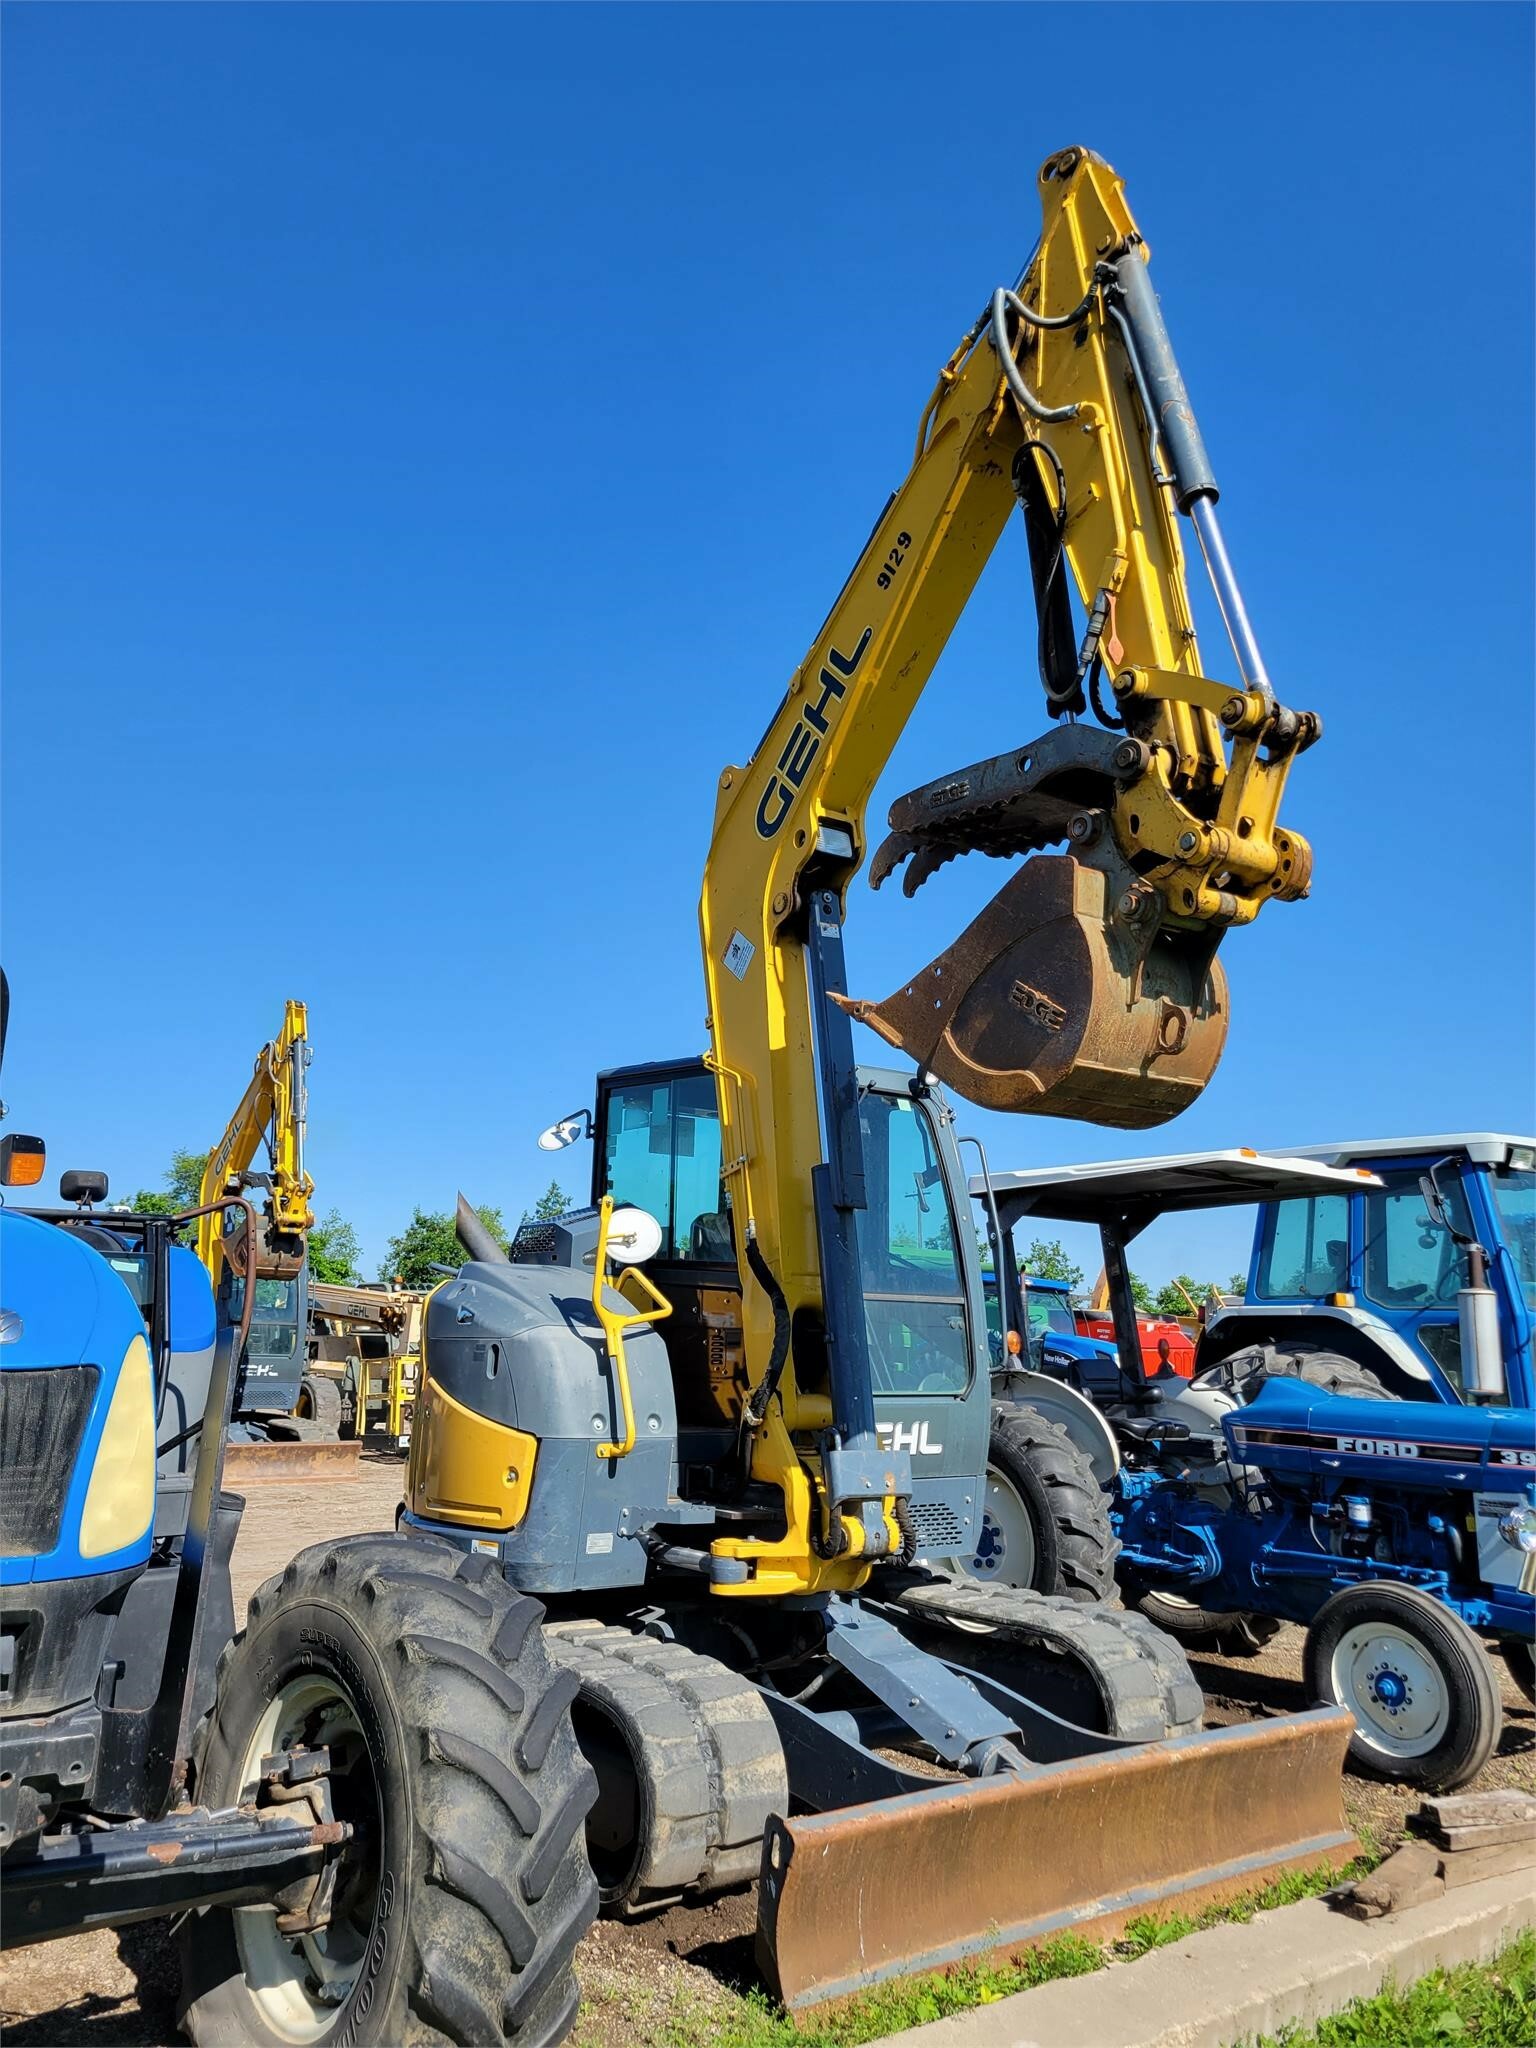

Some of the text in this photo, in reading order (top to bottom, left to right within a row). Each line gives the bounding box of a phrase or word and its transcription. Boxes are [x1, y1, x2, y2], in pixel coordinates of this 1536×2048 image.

[877, 531, 912, 590] 9129
[755, 626, 873, 841] GEHL
[930, 780, 970, 809] EDGE
[1009, 980, 1066, 1031] EDGE
[215, 1119, 243, 1176] GEHL
[347, 1303, 370, 1318] GEHL
[1043, 1353, 1055, 1363] New
[875, 1421, 944, 1455] EHL
[1336, 1437, 1419, 1458] FORD
[300, 1627, 341, 1653] SUPER
